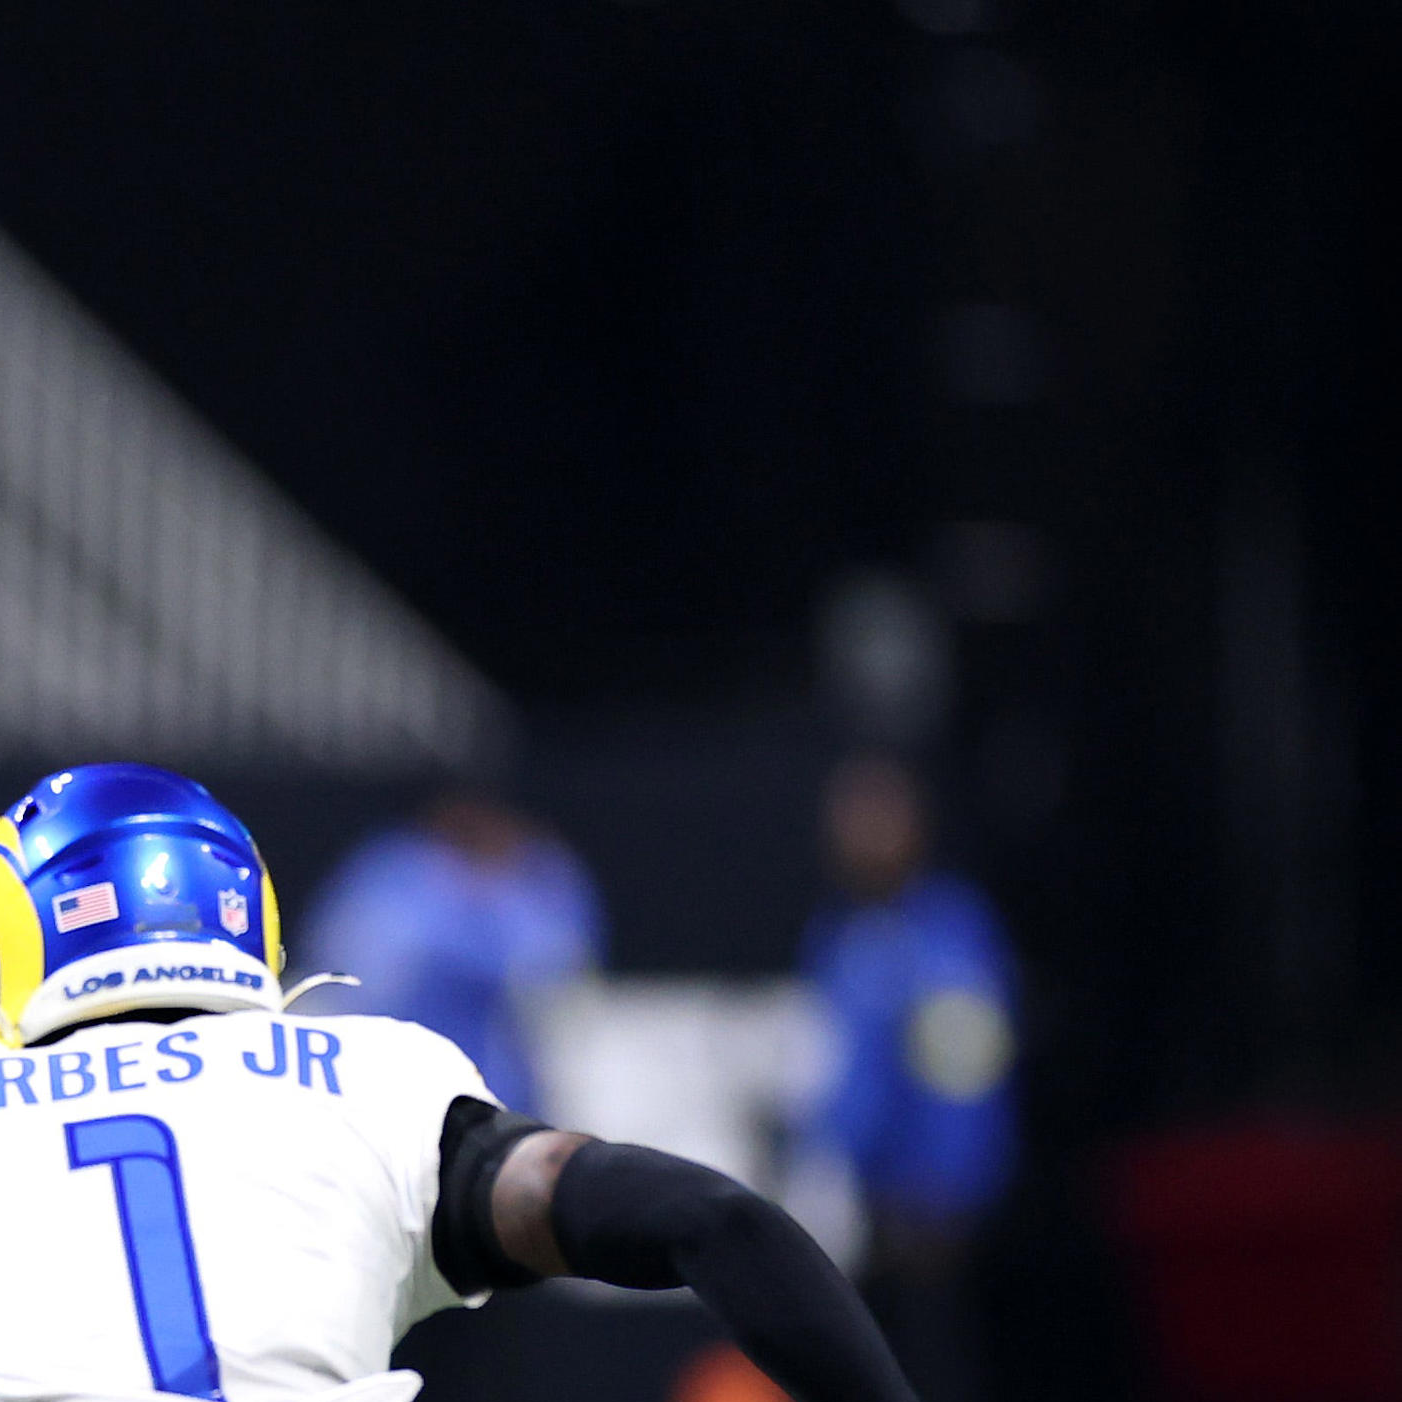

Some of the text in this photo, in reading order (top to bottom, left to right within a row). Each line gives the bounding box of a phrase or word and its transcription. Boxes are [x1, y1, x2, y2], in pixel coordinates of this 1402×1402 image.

[64, 965, 264, 1000] LOS ANGELES
[242, 1021, 343, 1096] JR
